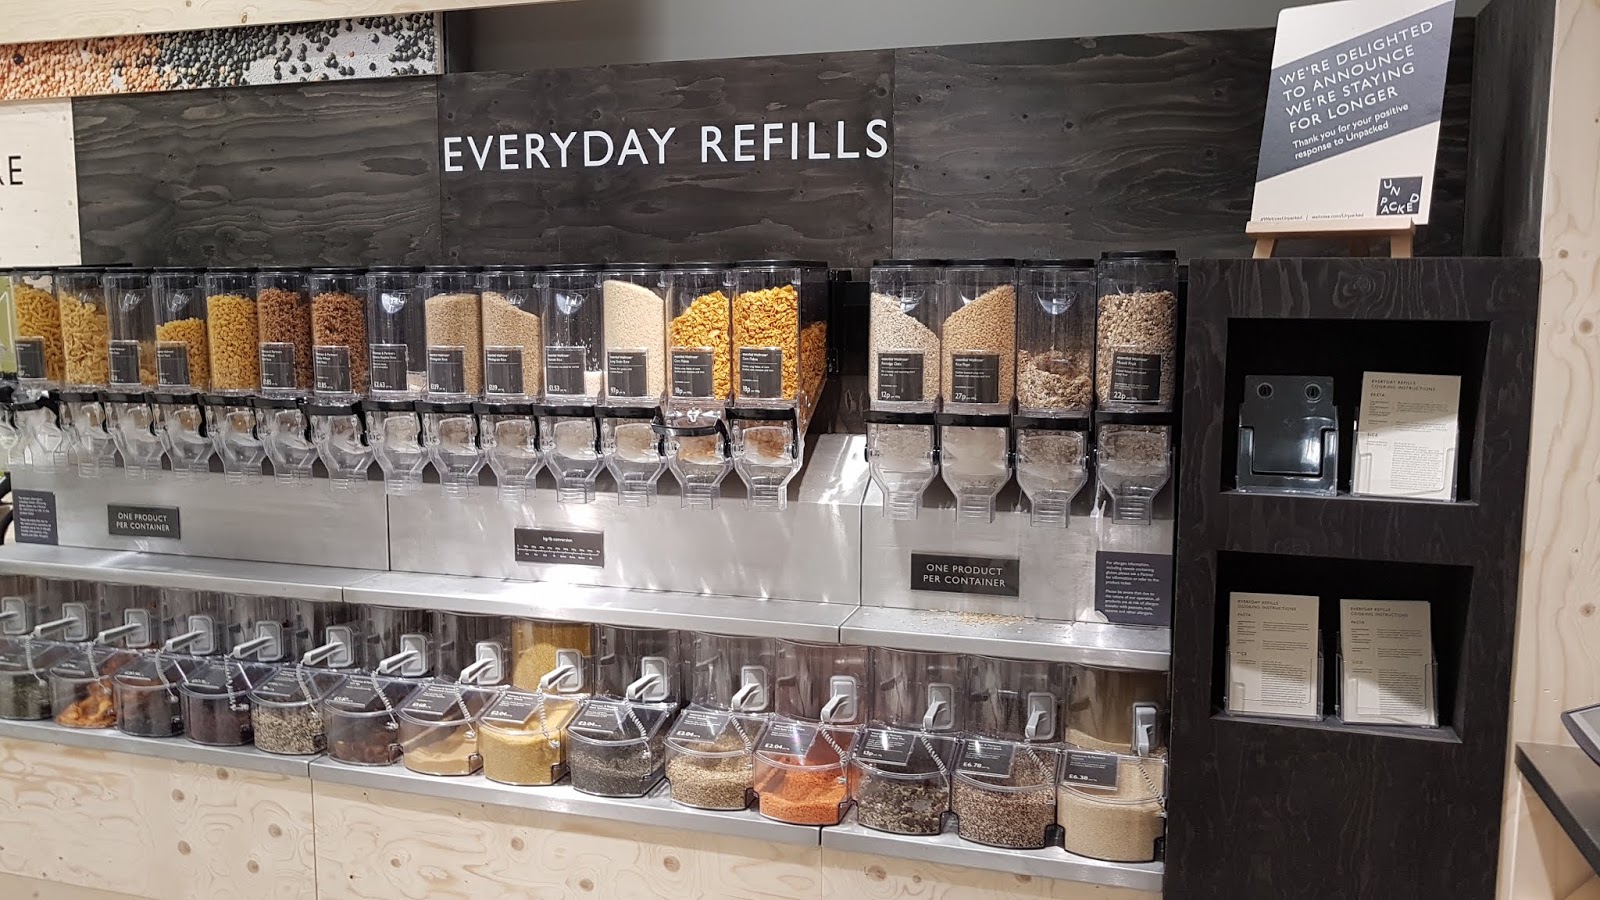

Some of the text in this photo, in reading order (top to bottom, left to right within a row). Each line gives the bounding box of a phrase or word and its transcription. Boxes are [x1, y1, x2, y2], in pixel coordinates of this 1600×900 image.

[1279, 20, 1434, 86] WE'RE DELIGHTED
[1282, 44, 1415, 101] TO ANNOUNCE
[1285, 61, 1415, 117] WE'RE STAYING
[1289, 86, 1399, 133] FOR LONGER
[1292, 103, 1409, 149] Thank you for your positive
[1294, 120, 1389, 160] response to Unpacked
[443, 118, 889, 172] EVERYDAY REFILLS
[0, 155, 23, 185] E
[880, 391, 890, 399] 12p
[954, 393, 966, 401] 27p
[1114, 392, 1126, 400] 22p
[116, 521, 170, 532] PER CONTAINER
[117, 512, 168, 523] ONE PRODUCT
[923, 574, 1006, 588] PER CONTAINER
[926, 563, 1003, 576] ONE PRODUCT
